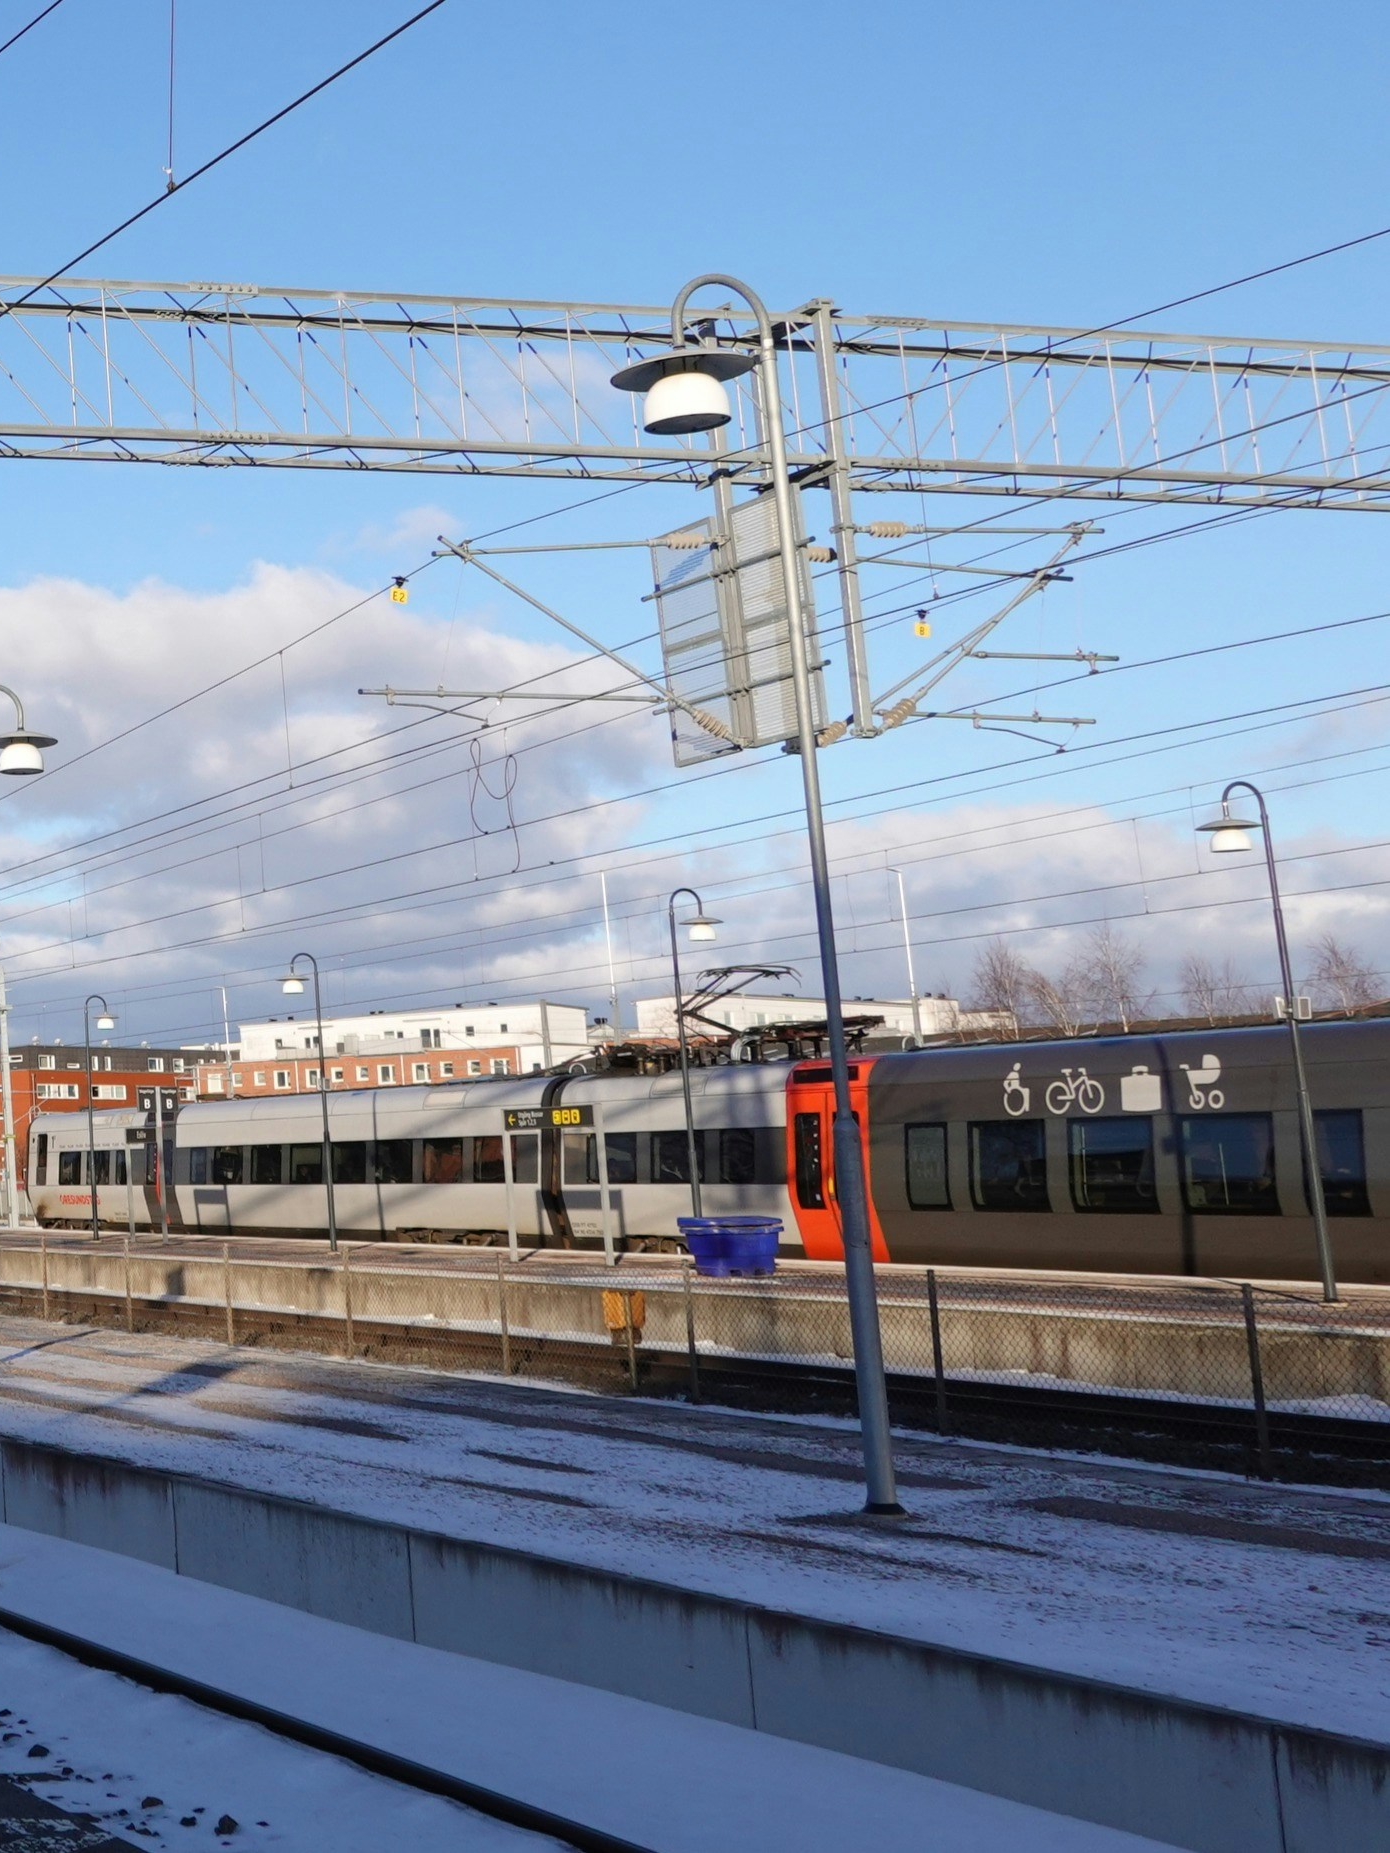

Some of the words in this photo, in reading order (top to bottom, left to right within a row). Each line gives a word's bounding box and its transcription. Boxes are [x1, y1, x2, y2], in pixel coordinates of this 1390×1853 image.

[392, 590, 406, 603] E2
[143, 1098, 151, 1110] B
[165, 1098, 173, 1110] B
